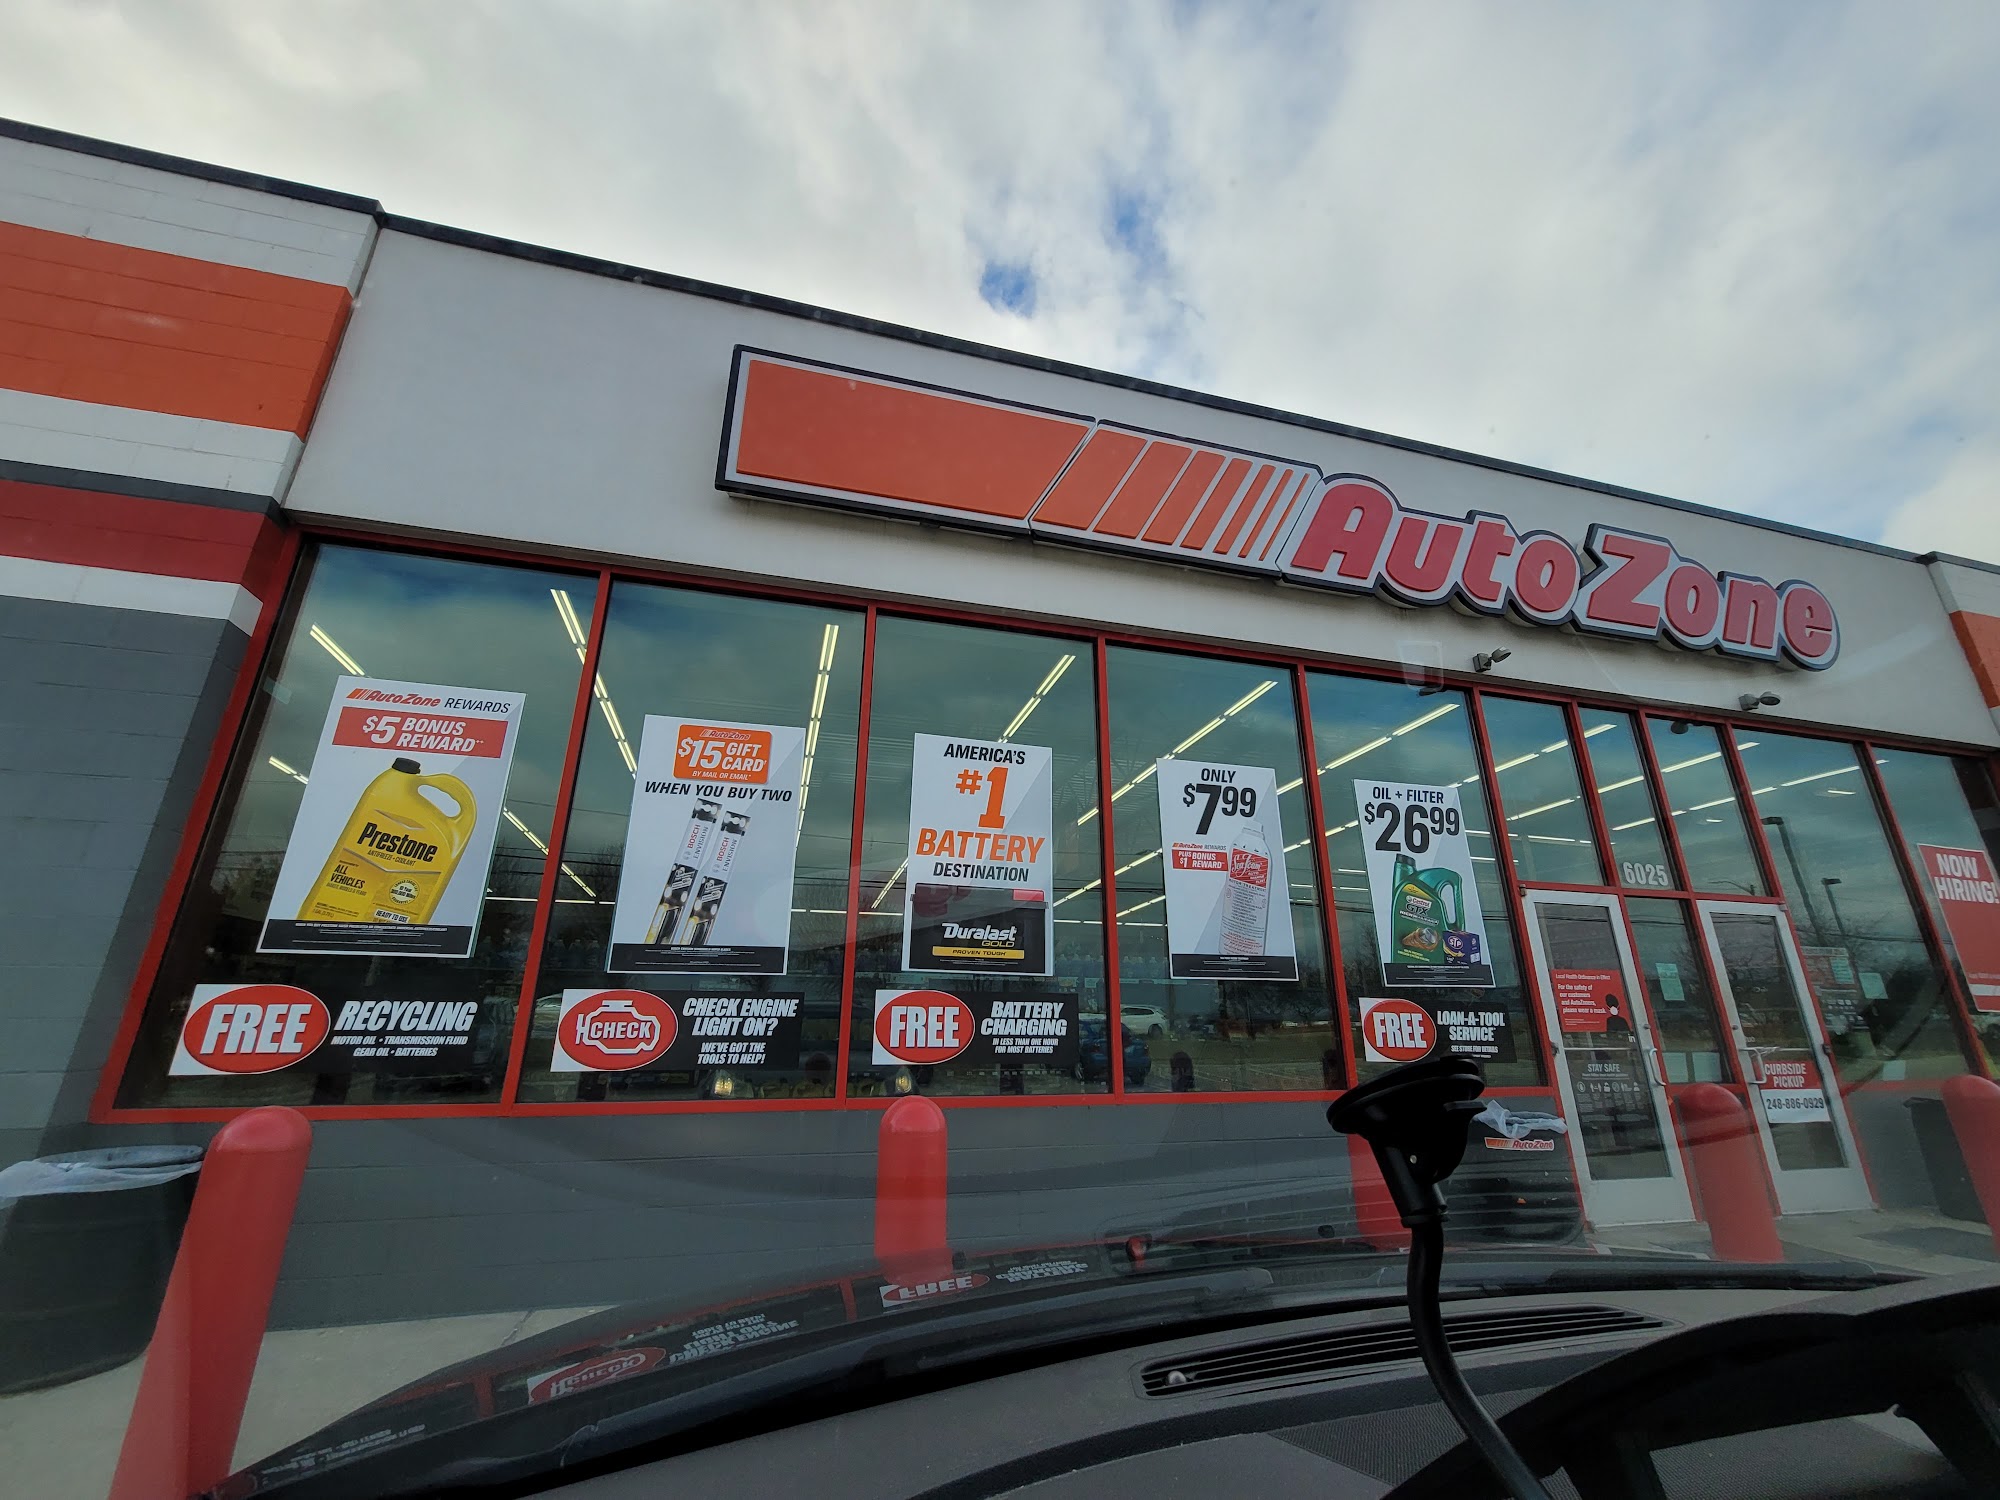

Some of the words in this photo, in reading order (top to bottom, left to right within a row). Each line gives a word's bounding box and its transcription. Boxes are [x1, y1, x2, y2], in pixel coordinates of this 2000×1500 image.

[1291, 483, 1833, 657] AutoZone
[365, 690, 441, 708] AutoZone
[444, 697, 512, 714] REWARDS
[363, 715, 402, 745] $5
[401, 717, 467, 736] BONUS
[708, 730, 750, 740] AutoZone
[678, 737, 726, 769] $15
[726, 742, 762, 757] GIFT
[944, 743, 1026, 765] AMERICA'S
[1201, 768, 1236, 784] ONLY
[644, 781, 691, 796] WHEN
[696, 784, 724, 798] YOU
[727, 787, 758, 800] BUY
[761, 788, 793, 802] TWO
[955, 766, 1009, 829] #1
[1372, 786, 1392, 800] OIL
[1406, 789, 1444, 804] FILTER
[356, 822, 438, 863] Prestone
[687, 824, 701, 849] BOSCH
[693, 826, 709, 859] ENVISION
[916, 827, 1046, 864] BATTERY
[716, 836, 730, 861] BOSCH
[722, 838, 738, 872] ENVISION
[1192, 852, 1216, 860] BONUS
[334, 864, 349, 875] ALL
[933, 861, 1029, 882] DESTINATION
[1179, 857, 1188, 868] $1
[1936, 853, 1979, 879] NOW
[330, 873, 366, 890] VEHICLES
[1622, 862, 1669, 886] 6025
[1934, 877, 2000, 904] HIRING!
[375, 909, 392, 920] READY
[1406, 903, 1429, 916] GTX
[941, 922, 1018, 941] Duralast
[981, 940, 1015, 948] GOLD
[1449, 936, 1462, 947] STP
[333, 1000, 478, 1031] RECYCLING
[682, 997, 741, 1017] CHECK
[740, 998, 799, 1017] ENGINE
[990, 1000, 1064, 1018] BATTERY
[692, 1017, 743, 1036] LIGHT
[742, 1017, 779, 1036] ON?
[889, 1005, 960, 1048] FREE
[980, 1018, 1068, 1036] CHARGING
[1437, 1010, 1506, 1027] LOAN-A-TOOL
[200, 1003, 313, 1054] FREE
[590, 1021, 652, 1039] CHECK
[1373, 1012, 1428, 1048] FREE
[330, 1035, 364, 1045] MOTOR
[362, 1035, 377, 1045] OIL
[384, 1035, 446, 1045] TRANSMISSION
[445, 1036, 469, 1045] FLUID
[701, 1042, 729, 1053] WE'VE
[729, 1042, 748, 1053] GOT
[748, 1042, 766, 1052] THE
[992, 1038, 999, 1046] IN
[1000, 1038, 1014, 1046] LESS
[1014, 1038, 1031, 1046] THAN
[1031, 1038, 1042, 1046] ONE
[1042, 1038, 1059, 1046] HOUR
[353, 1047, 377, 1056] GEAR
[376, 1047, 390, 1056] OIL
[394, 1047, 439, 1056] BATTERIES
[697, 1053, 727, 1064] TOOLS
[726, 1053, 740, 1064] TO
[739, 1053, 766, 1064] HELP!
[995, 1046, 1006, 1054] FOR
[1007, 1046, 1024, 1054] MOST
[1024, 1046, 1054, 1054] BATTERIES
[1587, 1063, 1603, 1073] STAY
[1603, 1063, 1620, 1073] SAFE
[1764, 1063, 1807, 1075] CURBSIDE
[1773, 1075, 1805, 1088] PICKUP
[1766, 1097, 1825, 1109] 248-886-0929
[1512, 1140, 1553, 1150] AutoZone
